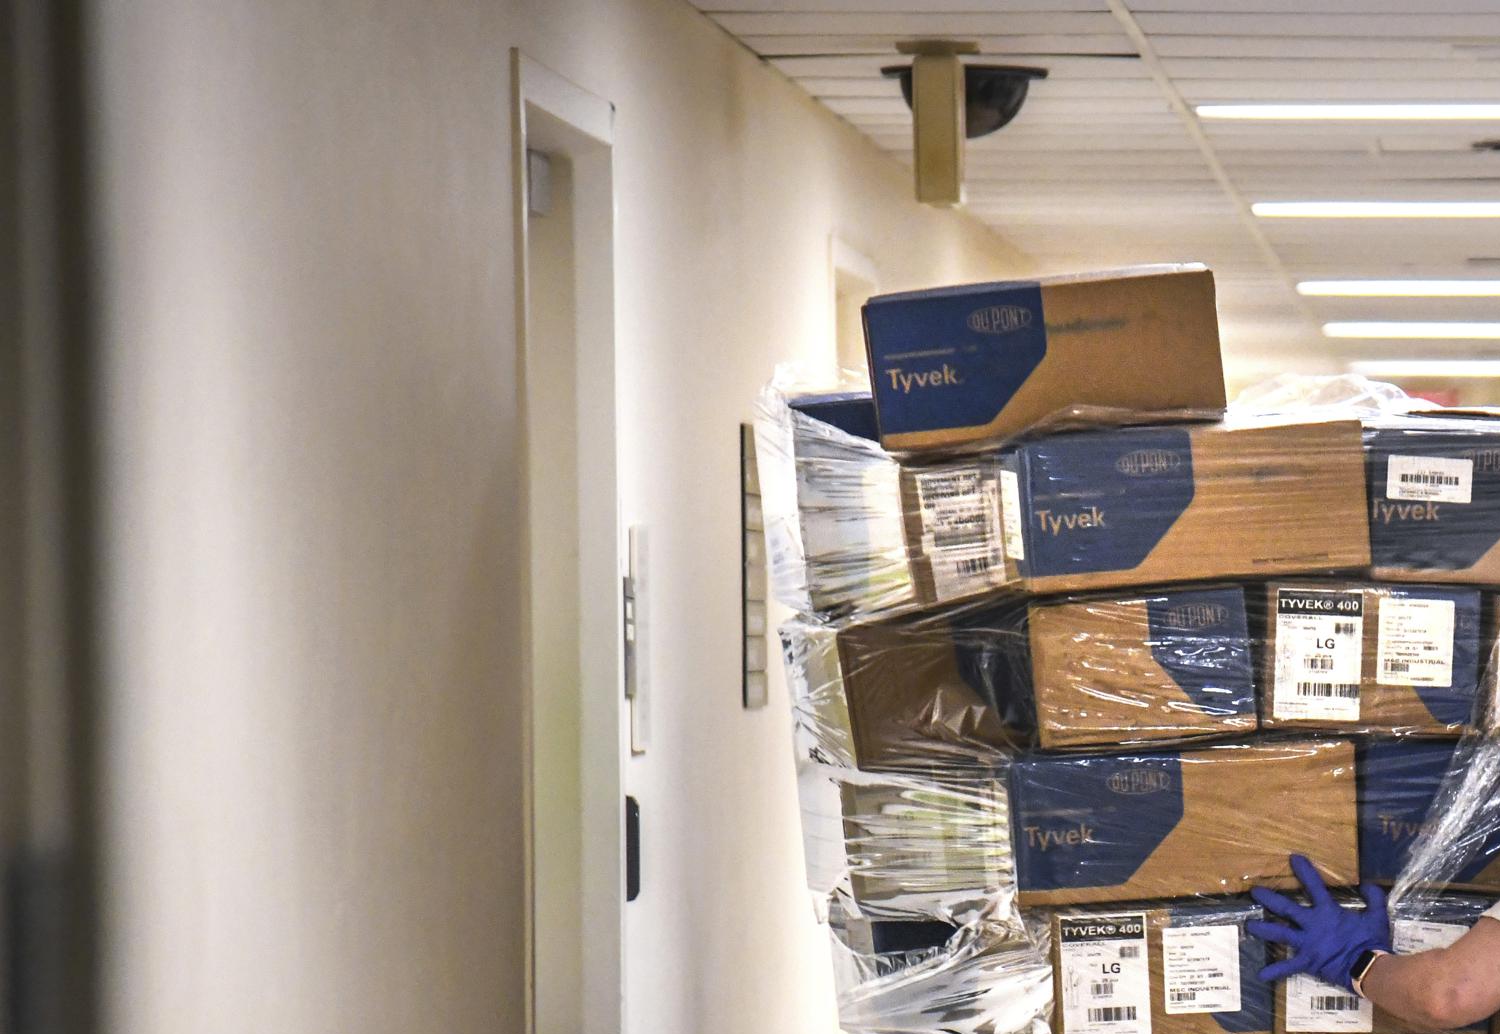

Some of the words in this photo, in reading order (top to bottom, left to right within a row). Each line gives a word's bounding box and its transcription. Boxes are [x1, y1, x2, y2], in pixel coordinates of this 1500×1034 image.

[884, 364, 958, 394] Tyvek
[1034, 506, 1106, 537] Tyvek
[1337, 600, 1359, 611] 400
[1316, 638, 1335, 649] LG
[1024, 824, 1095, 851] Tyvek
[1118, 924, 1141, 934] 400
[1102, 963, 1121, 974] LG
